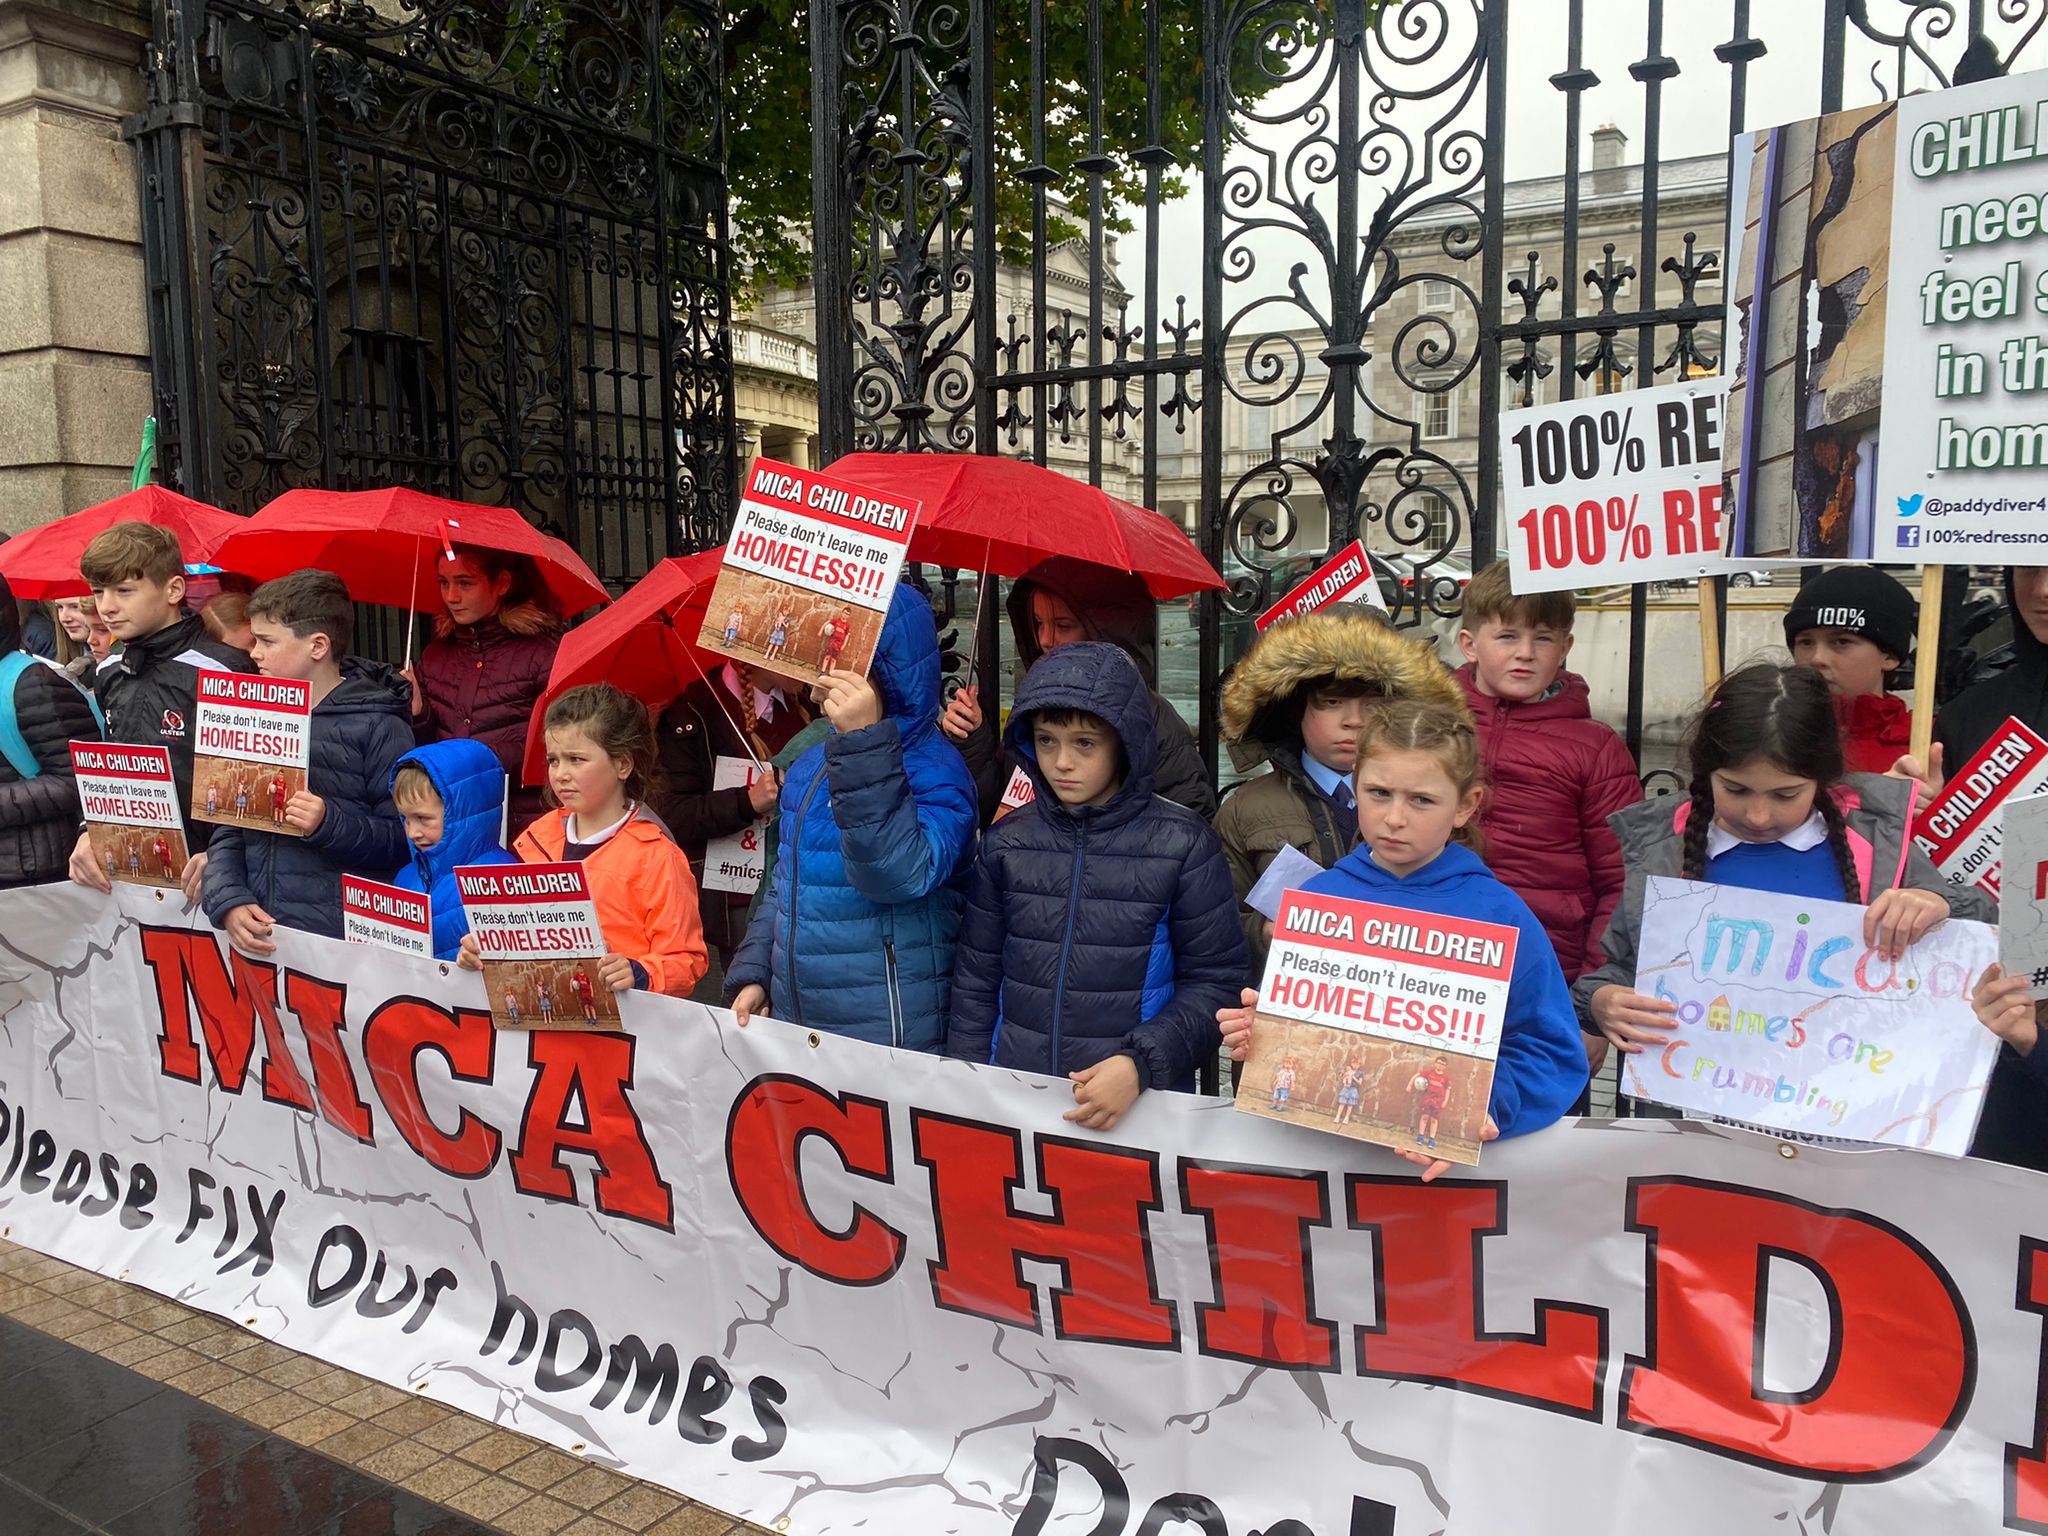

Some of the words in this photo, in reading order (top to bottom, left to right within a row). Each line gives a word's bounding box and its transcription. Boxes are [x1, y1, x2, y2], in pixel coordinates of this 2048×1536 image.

[1910, 98, 2048, 179] CHIL
[1939, 192, 2048, 250] nee
[1920, 261, 2022, 326] feel
[1936, 343, 1986, 398] in
[1512, 407, 1646, 487] 100%
[1657, 394, 1724, 468] RE
[752, 469, 803, 504] MICA
[807, 484, 908, 532] CHILDREN
[1925, 497, 2046, 516] @paddydiver4
[745, 510, 788, 535] Please
[790, 524, 825, 547] don't
[827, 534, 863, 557] leave
[866, 547, 888, 565] me
[1518, 493, 1651, 571] 100%
[733, 530, 885, 598] HOMELESS!!!
[1296, 555, 1363, 616] CHILDREN
[1817, 608, 1866, 627] 100%
[202, 677, 236, 698] MICA
[239, 681, 305, 706] CHILDREN
[200, 726, 300, 759] HOMELESS!!!
[203, 709, 231, 724] Please
[233, 714, 256, 728] don't
[258, 717, 282, 732] leave
[285, 723, 299, 733] me
[74, 751, 105, 769] MICA
[106, 753, 166, 774] CHILDREN
[1928, 732, 2033, 839] CHILDREN
[82, 781, 107, 794] Please
[109, 784, 129, 796] don't
[130, 785, 152, 797] leave
[154, 789, 167, 799] me
[85, 796, 173, 821] HOMELESS!!!
[741, 830, 758, 851] &
[346, 886, 371, 910] MICA
[373, 893, 426, 924] CHILDREN
[460, 875, 502, 896] MICA
[502, 872, 583, 896] CHILDREN
[348, 920, 370, 936] Please
[371, 927, 389, 942] don't
[390, 931, 410, 948] leave
[411, 939, 424, 952] me
[472, 911, 506, 925] Please
[508, 911, 535, 925] don't
[536, 910, 565, 924] leave
[568, 911, 586, 921] me
[476, 927, 594, 952] HOMELESS!!!
[1285, 905, 1355, 941] MICA
[1363, 919, 1504, 968] CHILDREN
[1281, 951, 1341, 978] Please
[1346, 964, 1396, 988] don't
[1399, 973, 1450, 998] leave
[1456, 987, 1487, 1005] me
[1269, 973, 1486, 1045] HOMELESS!!!
[1827, 1032, 1895, 1074] are
[141, 924, 675, 1234] MICA
[725, 1073, 2048, 1535] CHILD
[175, 1167, 286, 1277] FIX
[479, 1260, 788, 1462] homes
